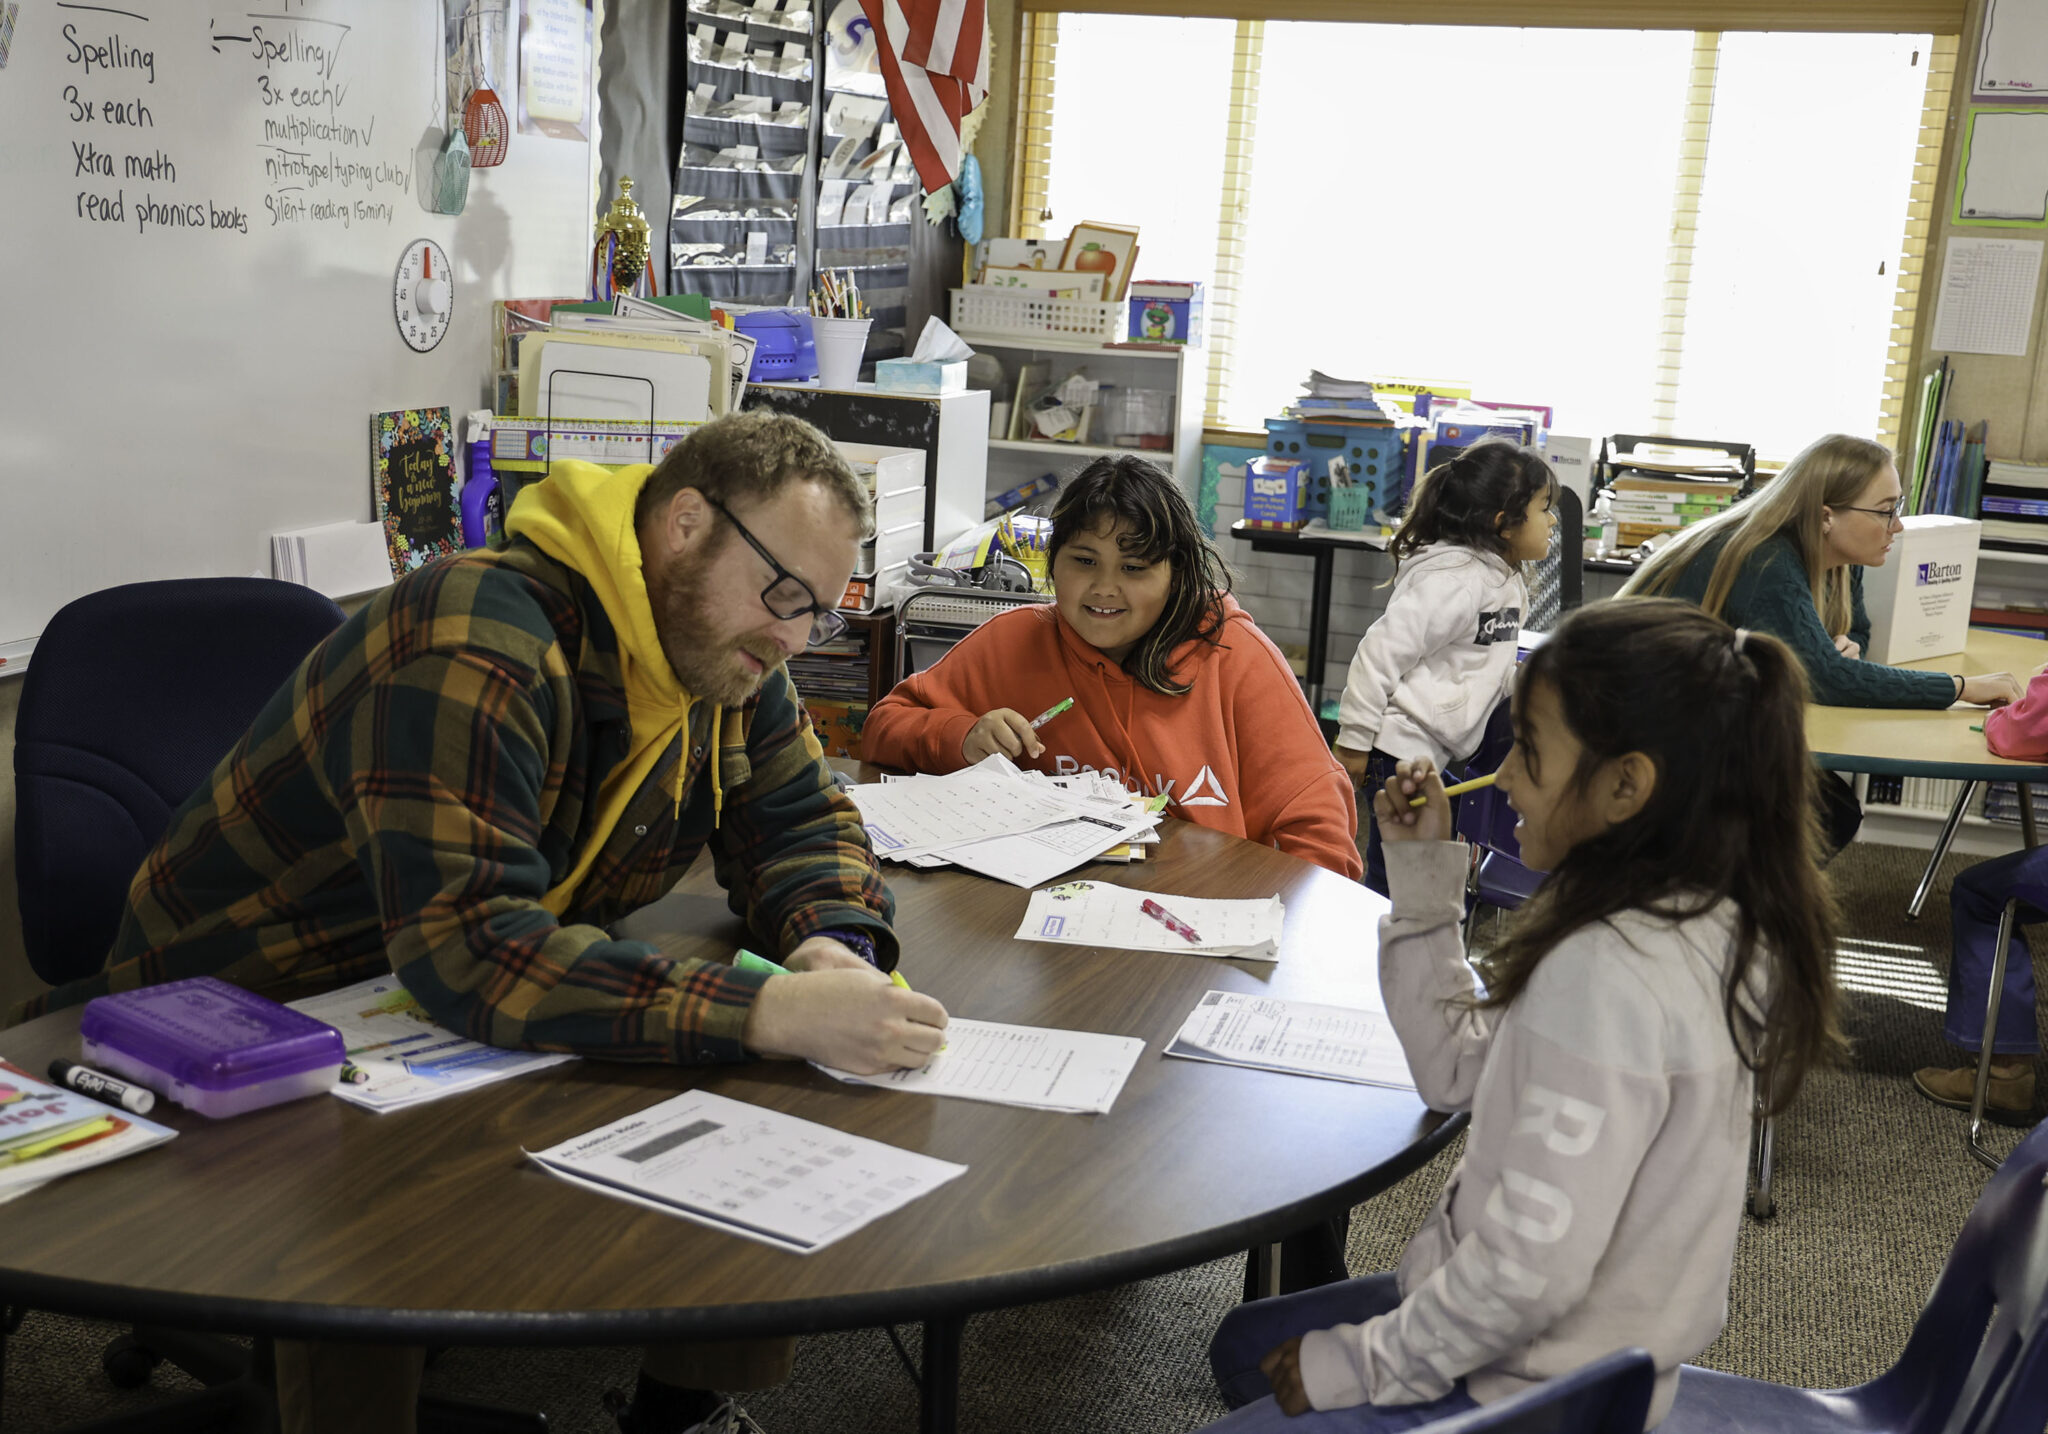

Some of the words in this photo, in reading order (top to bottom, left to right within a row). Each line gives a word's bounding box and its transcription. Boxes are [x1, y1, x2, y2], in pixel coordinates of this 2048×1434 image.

[63, 24, 154, 84] Spelling
[252, 26, 324, 76] Spelling
[63, 85, 95, 122] 3x
[102, 98, 153, 127] each
[257, 75, 284, 106] 3x
[291, 80, 333, 115] each
[265, 114, 358, 148] multiplication
[72, 141, 115, 177] Xtra
[125, 150, 176, 183] math
[375, 160, 404, 187] club
[77, 189, 125, 222] read
[136, 193, 205, 234] phonics
[210, 199, 248, 234] books
[311, 199, 349, 229] reading
[1929, 561, 1962, 578] Barton
